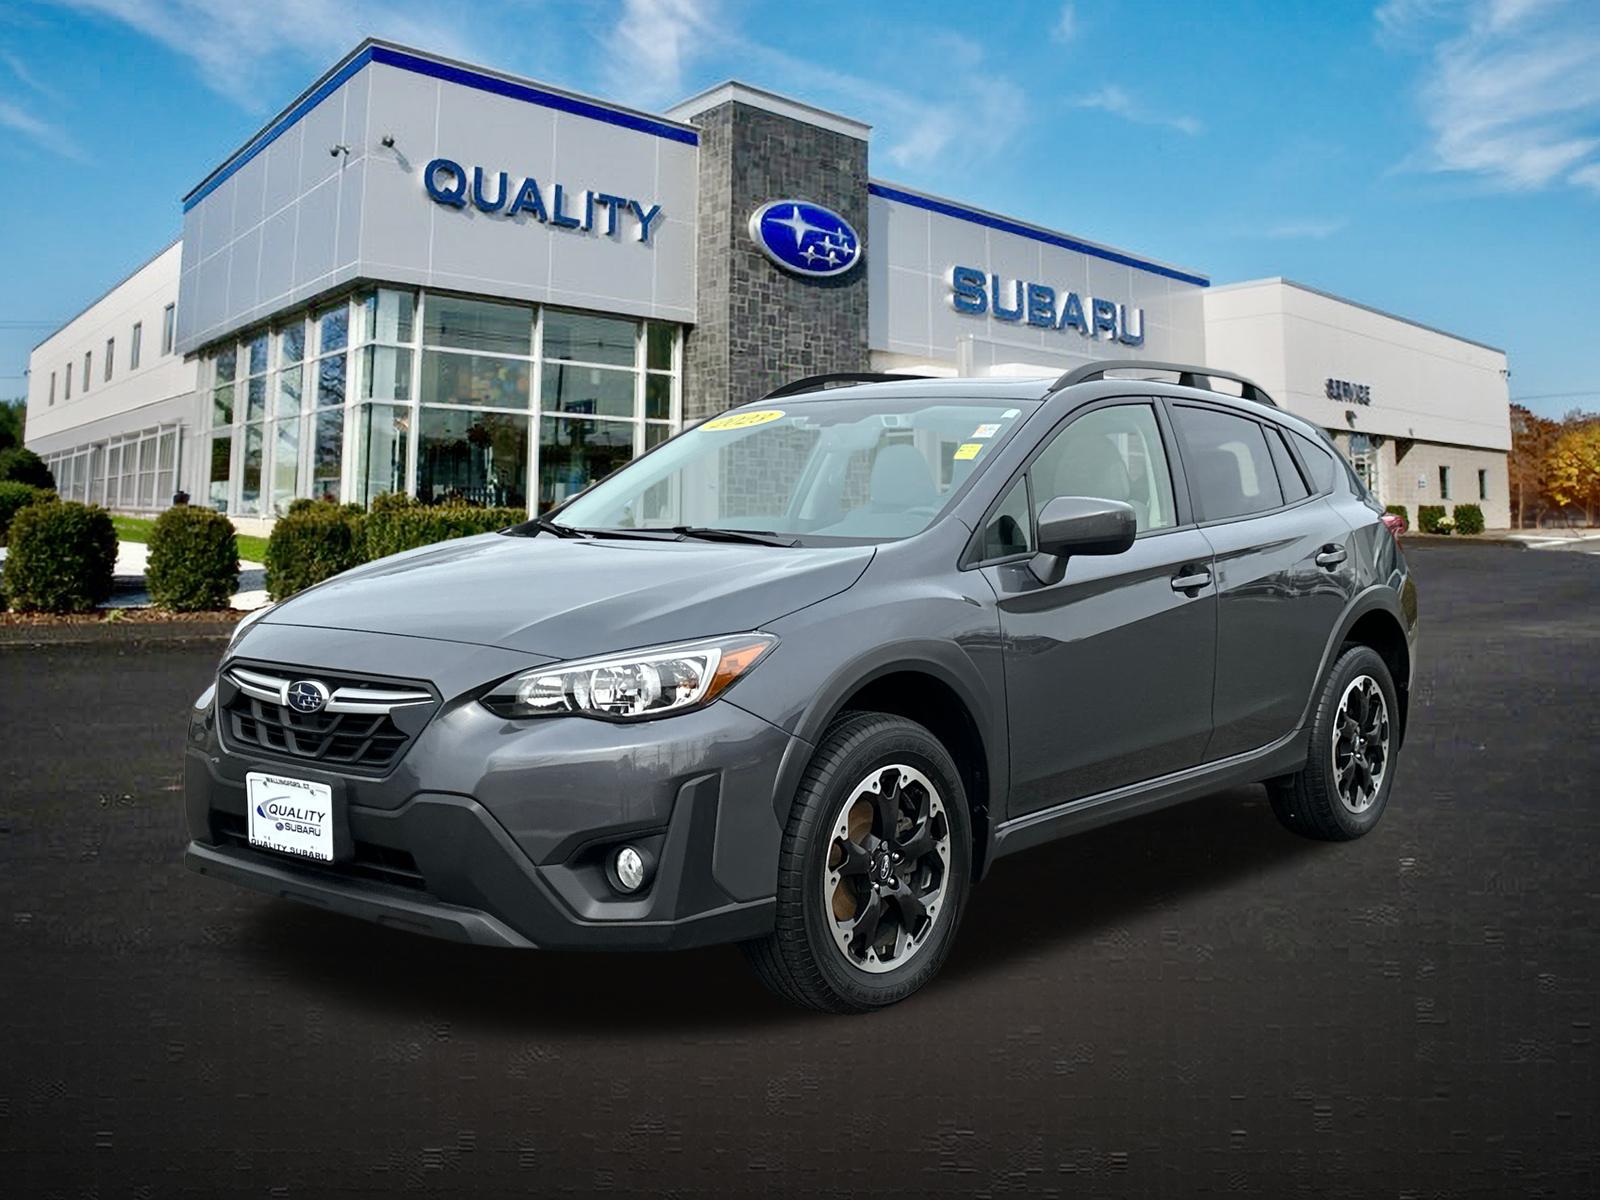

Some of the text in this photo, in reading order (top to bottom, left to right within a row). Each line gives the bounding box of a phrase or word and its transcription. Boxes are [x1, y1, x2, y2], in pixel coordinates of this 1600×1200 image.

[423, 158, 662, 243] QUALITY
[949, 265, 1145, 346] SUBARU
[1326, 378, 1371, 406] SERVICE
[268, 803, 326, 823] QUALITY
[284, 822, 321, 837] SUBARU
[250, 838, 328, 860] QUALITY SUBARU
